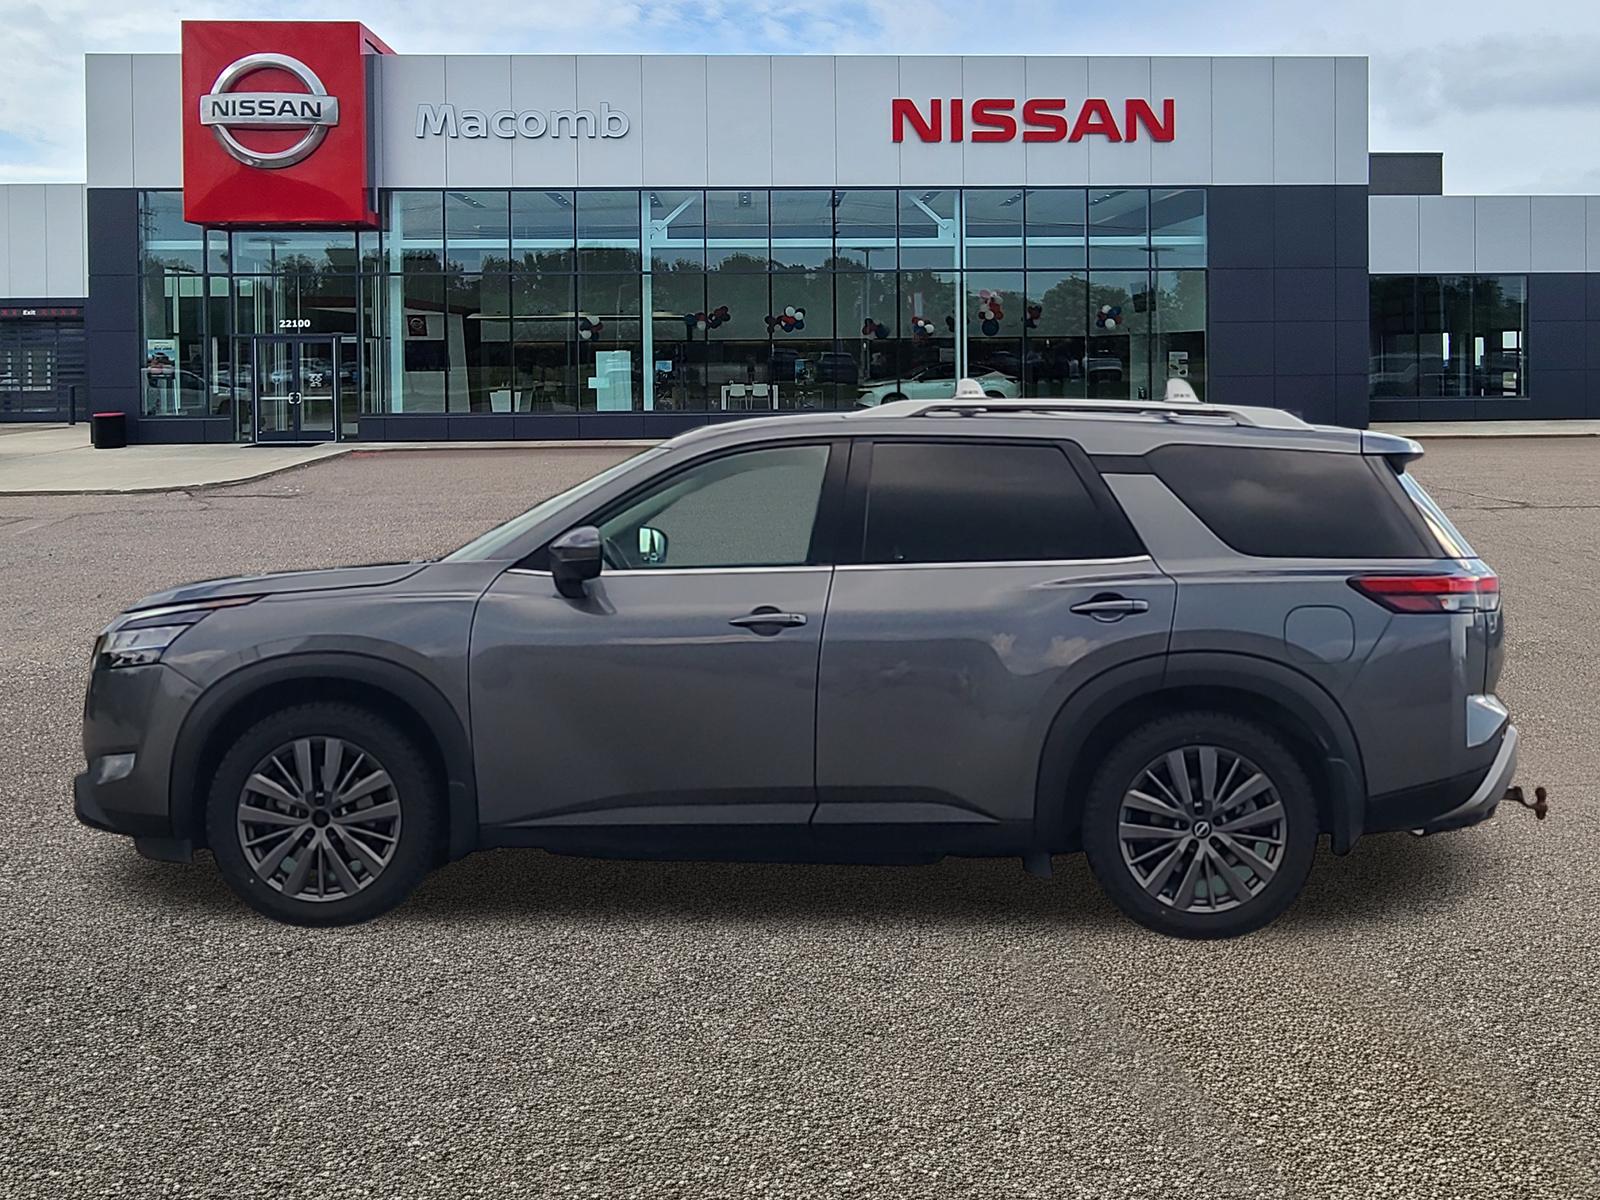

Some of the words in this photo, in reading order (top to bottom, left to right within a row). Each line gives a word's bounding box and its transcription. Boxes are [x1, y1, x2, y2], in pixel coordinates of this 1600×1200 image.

[212, 100, 322, 118] NISSAN
[415, 102, 630, 139] Macomb
[891, 98, 1176, 143] NISSAN
[279, 319, 311, 328] 22100
